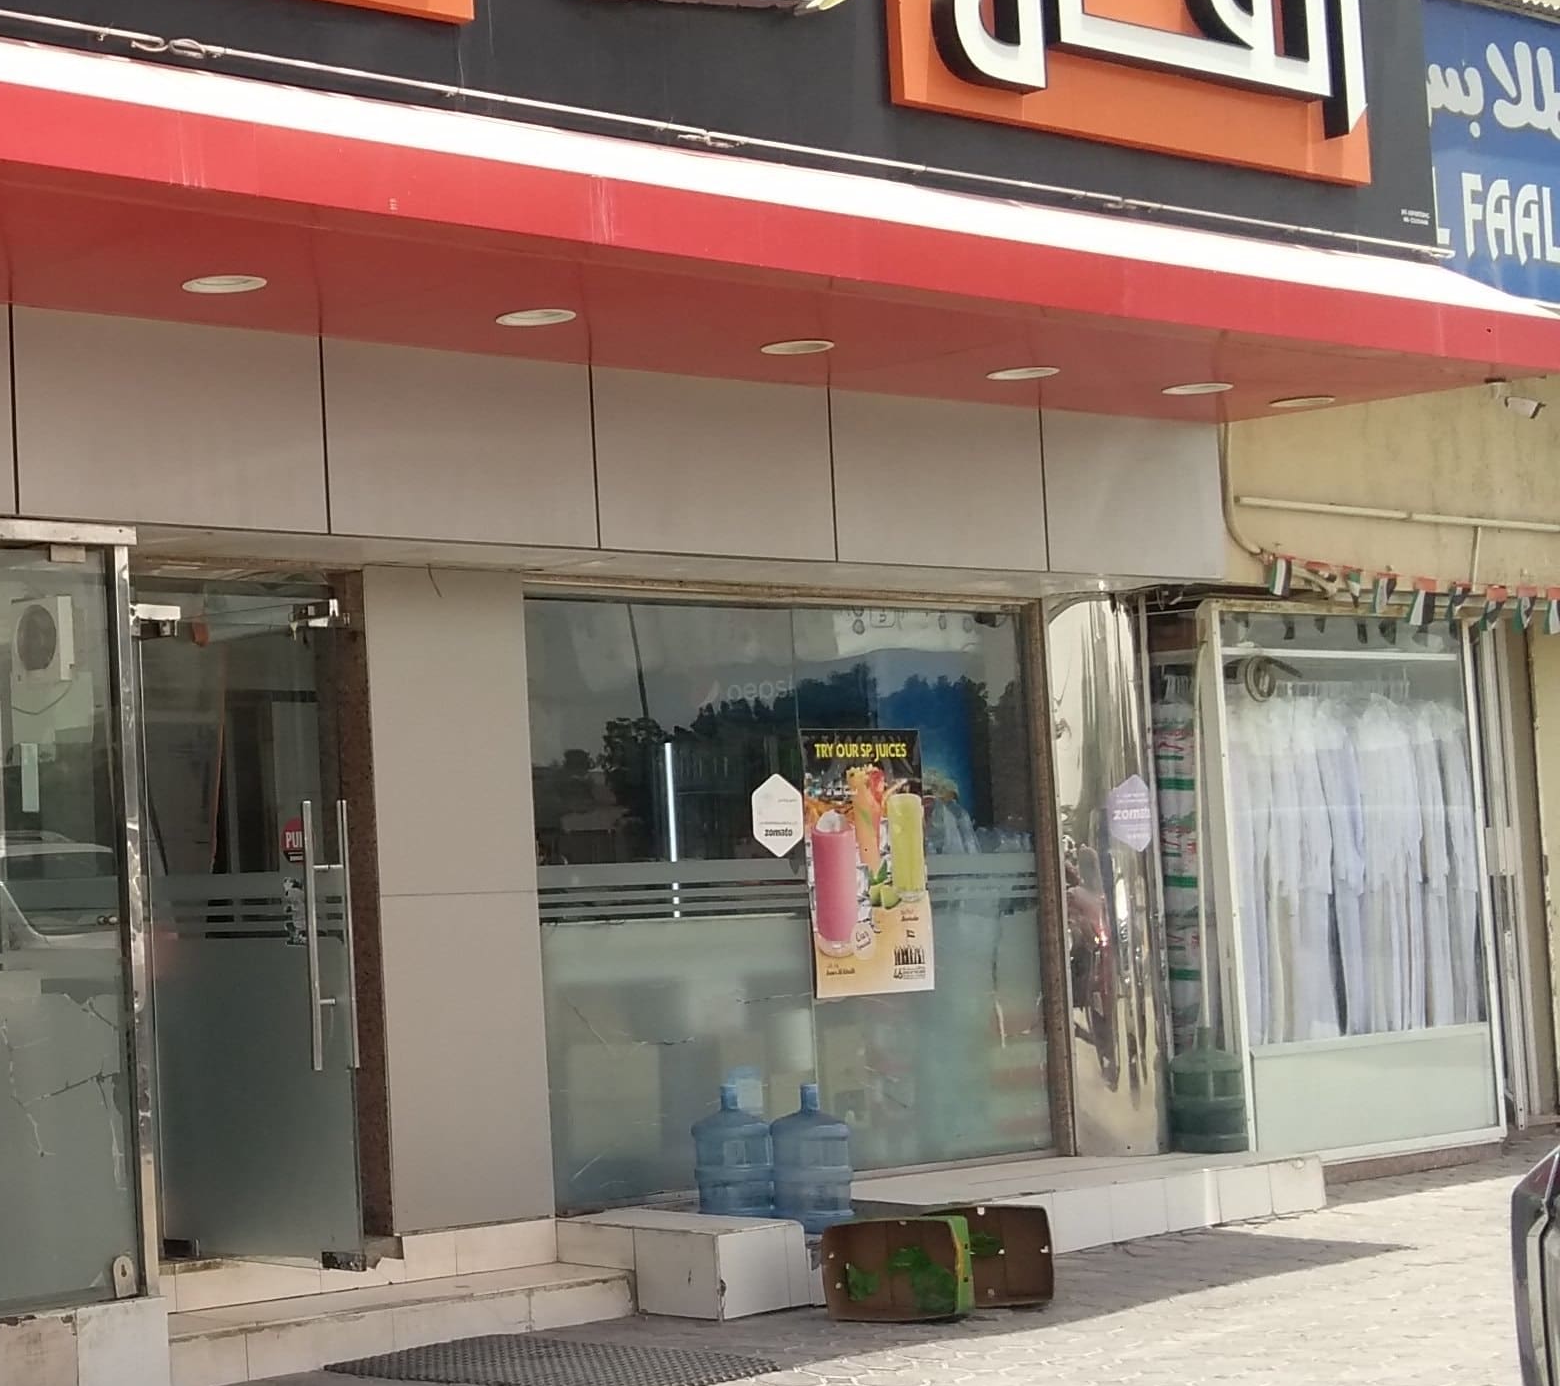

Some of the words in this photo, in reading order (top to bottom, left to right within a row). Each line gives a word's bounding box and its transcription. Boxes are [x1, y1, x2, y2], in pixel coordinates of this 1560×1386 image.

[1461, 172, 1560, 266] FAAL
[814, 743, 835, 759] TRY
[836, 743, 860, 759] OUR
[874, 743, 907, 763] JUICES
[764, 827, 793, 837] zomato
